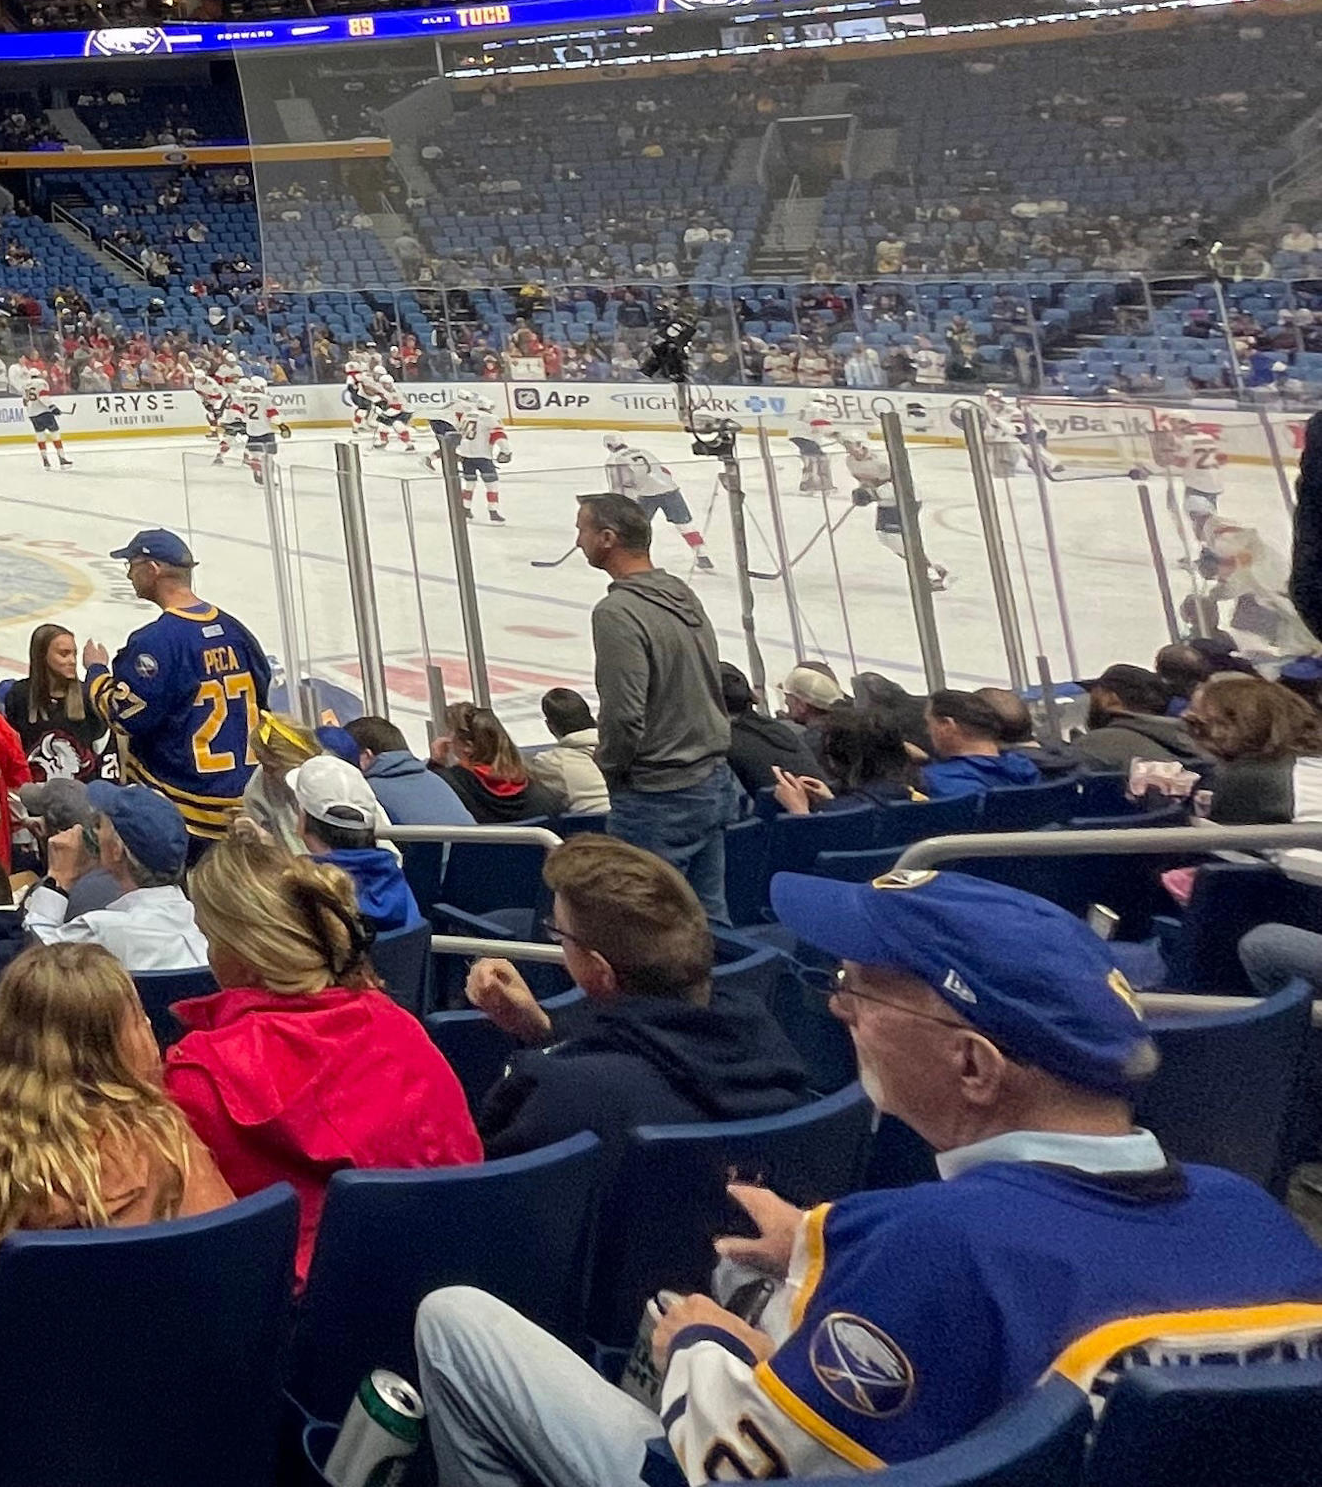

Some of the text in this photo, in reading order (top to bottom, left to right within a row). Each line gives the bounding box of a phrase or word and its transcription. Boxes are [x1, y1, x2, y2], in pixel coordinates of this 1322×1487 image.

[349, 17, 374, 37] 89
[456, 6, 510, 27] TUCH
[217, 30, 274, 41] FORWARD
[204, 646, 240, 675] PECA
[192, 672, 261, 773] 27
